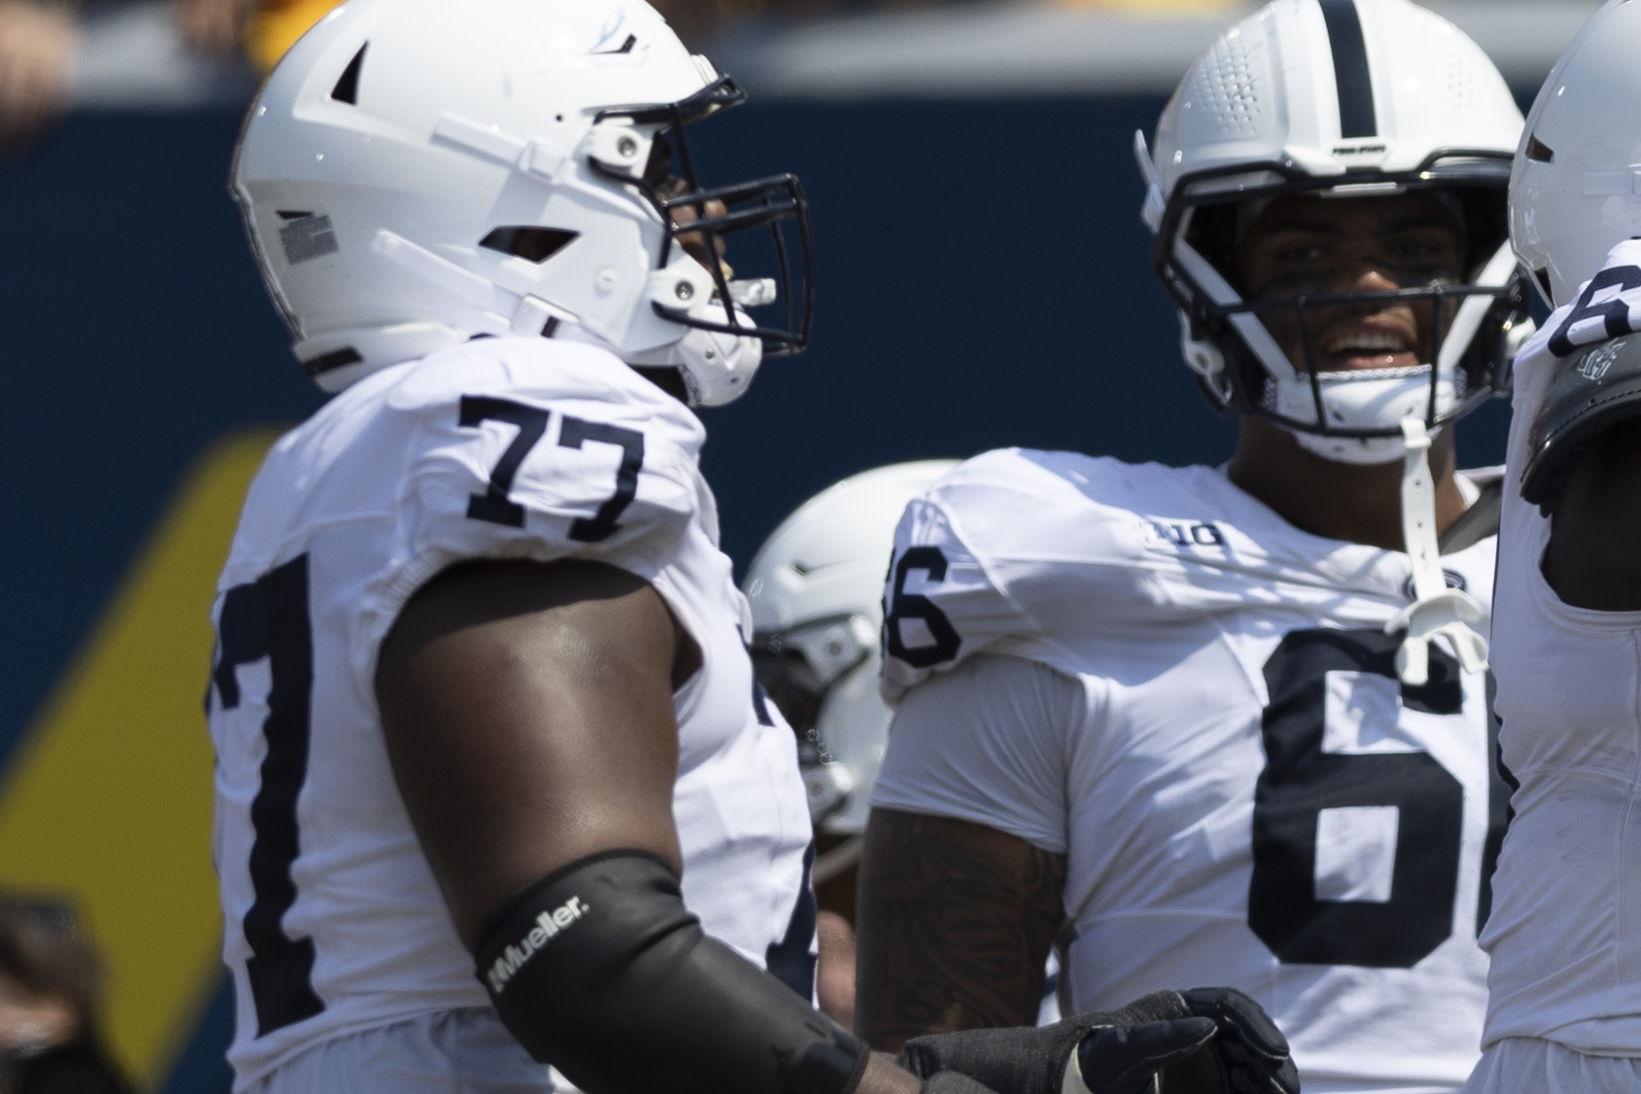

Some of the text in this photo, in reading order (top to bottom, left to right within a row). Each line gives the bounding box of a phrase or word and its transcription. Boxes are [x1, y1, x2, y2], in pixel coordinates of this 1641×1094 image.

[458, 393, 645, 543] 77
[880, 544, 963, 669] 6
[204, 552, 327, 1040] 7
[1247, 627, 1521, 969] 6
[491, 895, 585, 986] Mueller
